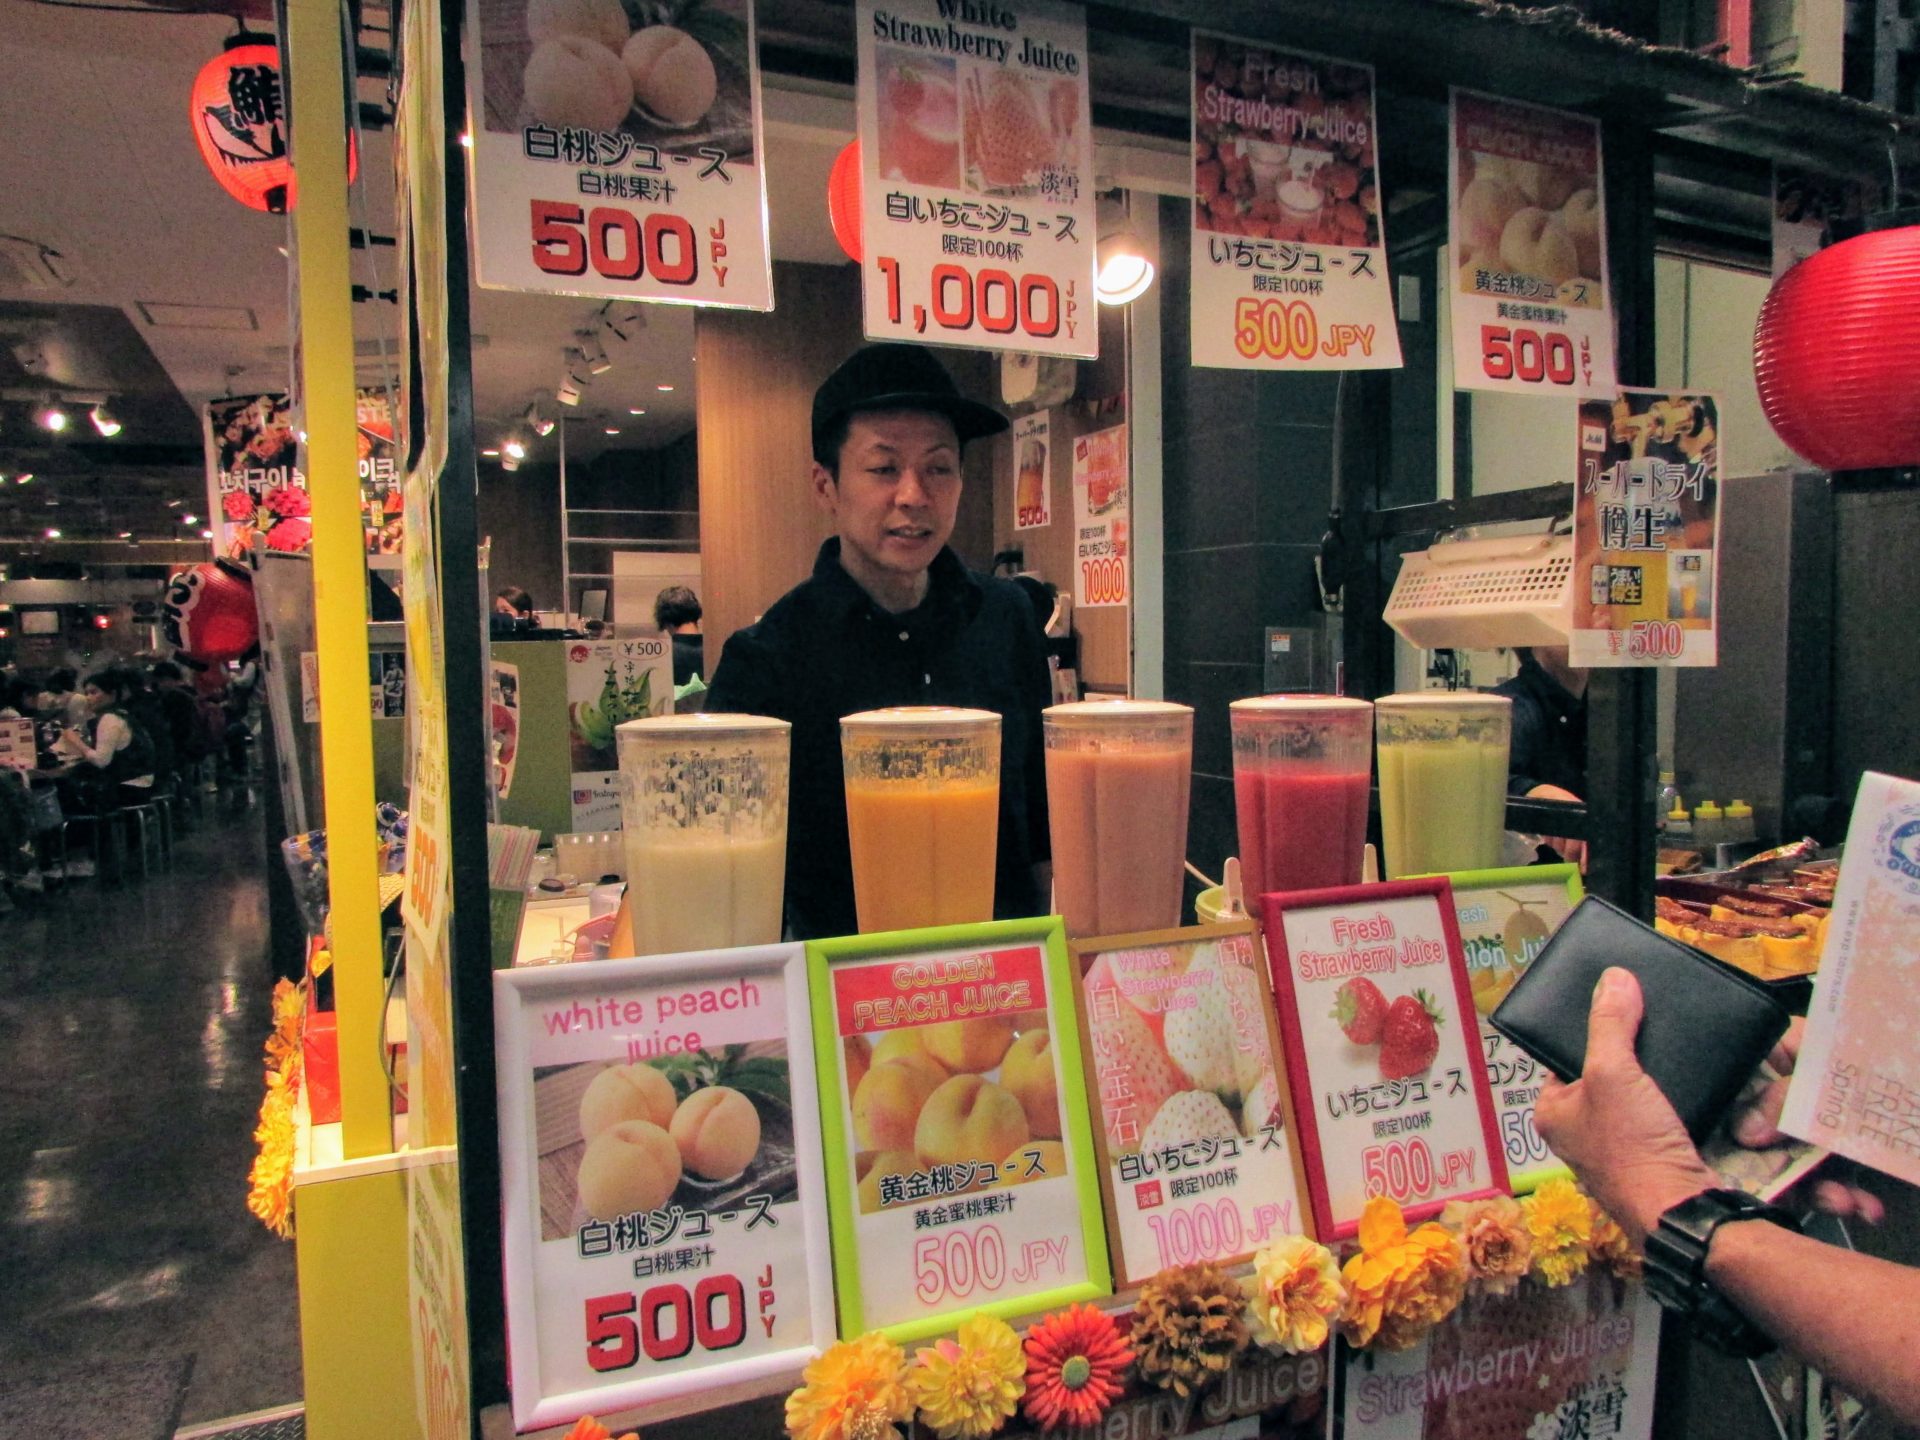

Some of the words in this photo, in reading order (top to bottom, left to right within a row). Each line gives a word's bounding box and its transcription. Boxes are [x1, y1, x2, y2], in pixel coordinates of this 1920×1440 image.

[936, 0, 1017, 32] White
[873, 9, 1011, 63] Strawberry
[1017, 36, 1081, 77] Juice
[1244, 52, 1320, 94] Fresh
[1203, 87, 1309, 135] Strawberry
[1314, 105, 1368, 147] Juice
[524, 125, 732, 184] 白桃ジュース
[578, 172, 677, 205] 白桃果汁
[530, 199, 698, 286] 500
[708, 216, 729, 288] JPY
[884, 190, 1078, 244] 白いちごジュース
[941, 235, 1025, 262] 限定100杯
[1207, 236, 1377, 279] いちごジュース
[877, 255, 1061, 337] 1,000
[1064, 279, 1078, 340] JPY
[1252, 273, 1324, 297] 限定100杯
[1235, 297, 1317, 362] 500
[1321, 322, 1376, 359] JPY
[1480, 324, 1577, 386] 500
[1579, 334, 1593, 388] JPY
[359, 456, 394, 482] 이크
[1599, 503, 1668, 552] 樽生
[1081, 556, 1126, 605] 1000
[1330, 913, 1395, 946] Fresh
[892, 953, 996, 990] GOLDEN
[1117, 949, 1172, 973] White
[1120, 968, 1217, 998] Strawberry
[1298, 944, 1398, 984] Strawberry
[1399, 937, 1447, 968] Juice
[544, 996, 646, 1037] white
[655, 977, 761, 1028] peach
[855, 989, 948, 1030] PEACH
[952, 980, 1033, 1017] JUICE
[1150, 991, 1199, 1014] Juice
[625, 1028, 702, 1066] juice
[1088, 982, 1141, 1147] 白い宝石
[1326, 1068, 1469, 1121] いちごジュース
[1817, 1059, 1857, 1130] Spring
[1857, 1073, 1904, 1148] FREE
[1372, 1113, 1434, 1140] 限定100杯
[1501, 1106, 1548, 1167] 50
[879, 1150, 1047, 1206] 黄金桃ジュース
[1117, 1125, 1283, 1184] 白いちごジュース
[1362, 1135, 1434, 1200] 500
[1436, 1150, 1477, 1190] JPY
[1169, 1168, 1239, 1200] 限定100杯
[576, 1194, 779, 1259] 白桃ジュース
[913, 1192, 1017, 1231] 黄金蜜桃果汁
[1147, 1196, 1244, 1272] 1000
[1246, 1199, 1294, 1245] JPY
[632, 1246, 715, 1279] 白桃果汁
[914, 1225, 1006, 1305] 500
[1010, 1236, 1070, 1285] JPY
[585, 1272, 748, 1372] 500
[756, 1264, 776, 1339] JPY
[1200, 1355, 1325, 1420] Juice
[1356, 1332, 1543, 1426] Strawberry
[1547, 1310, 1633, 1368] Juice
